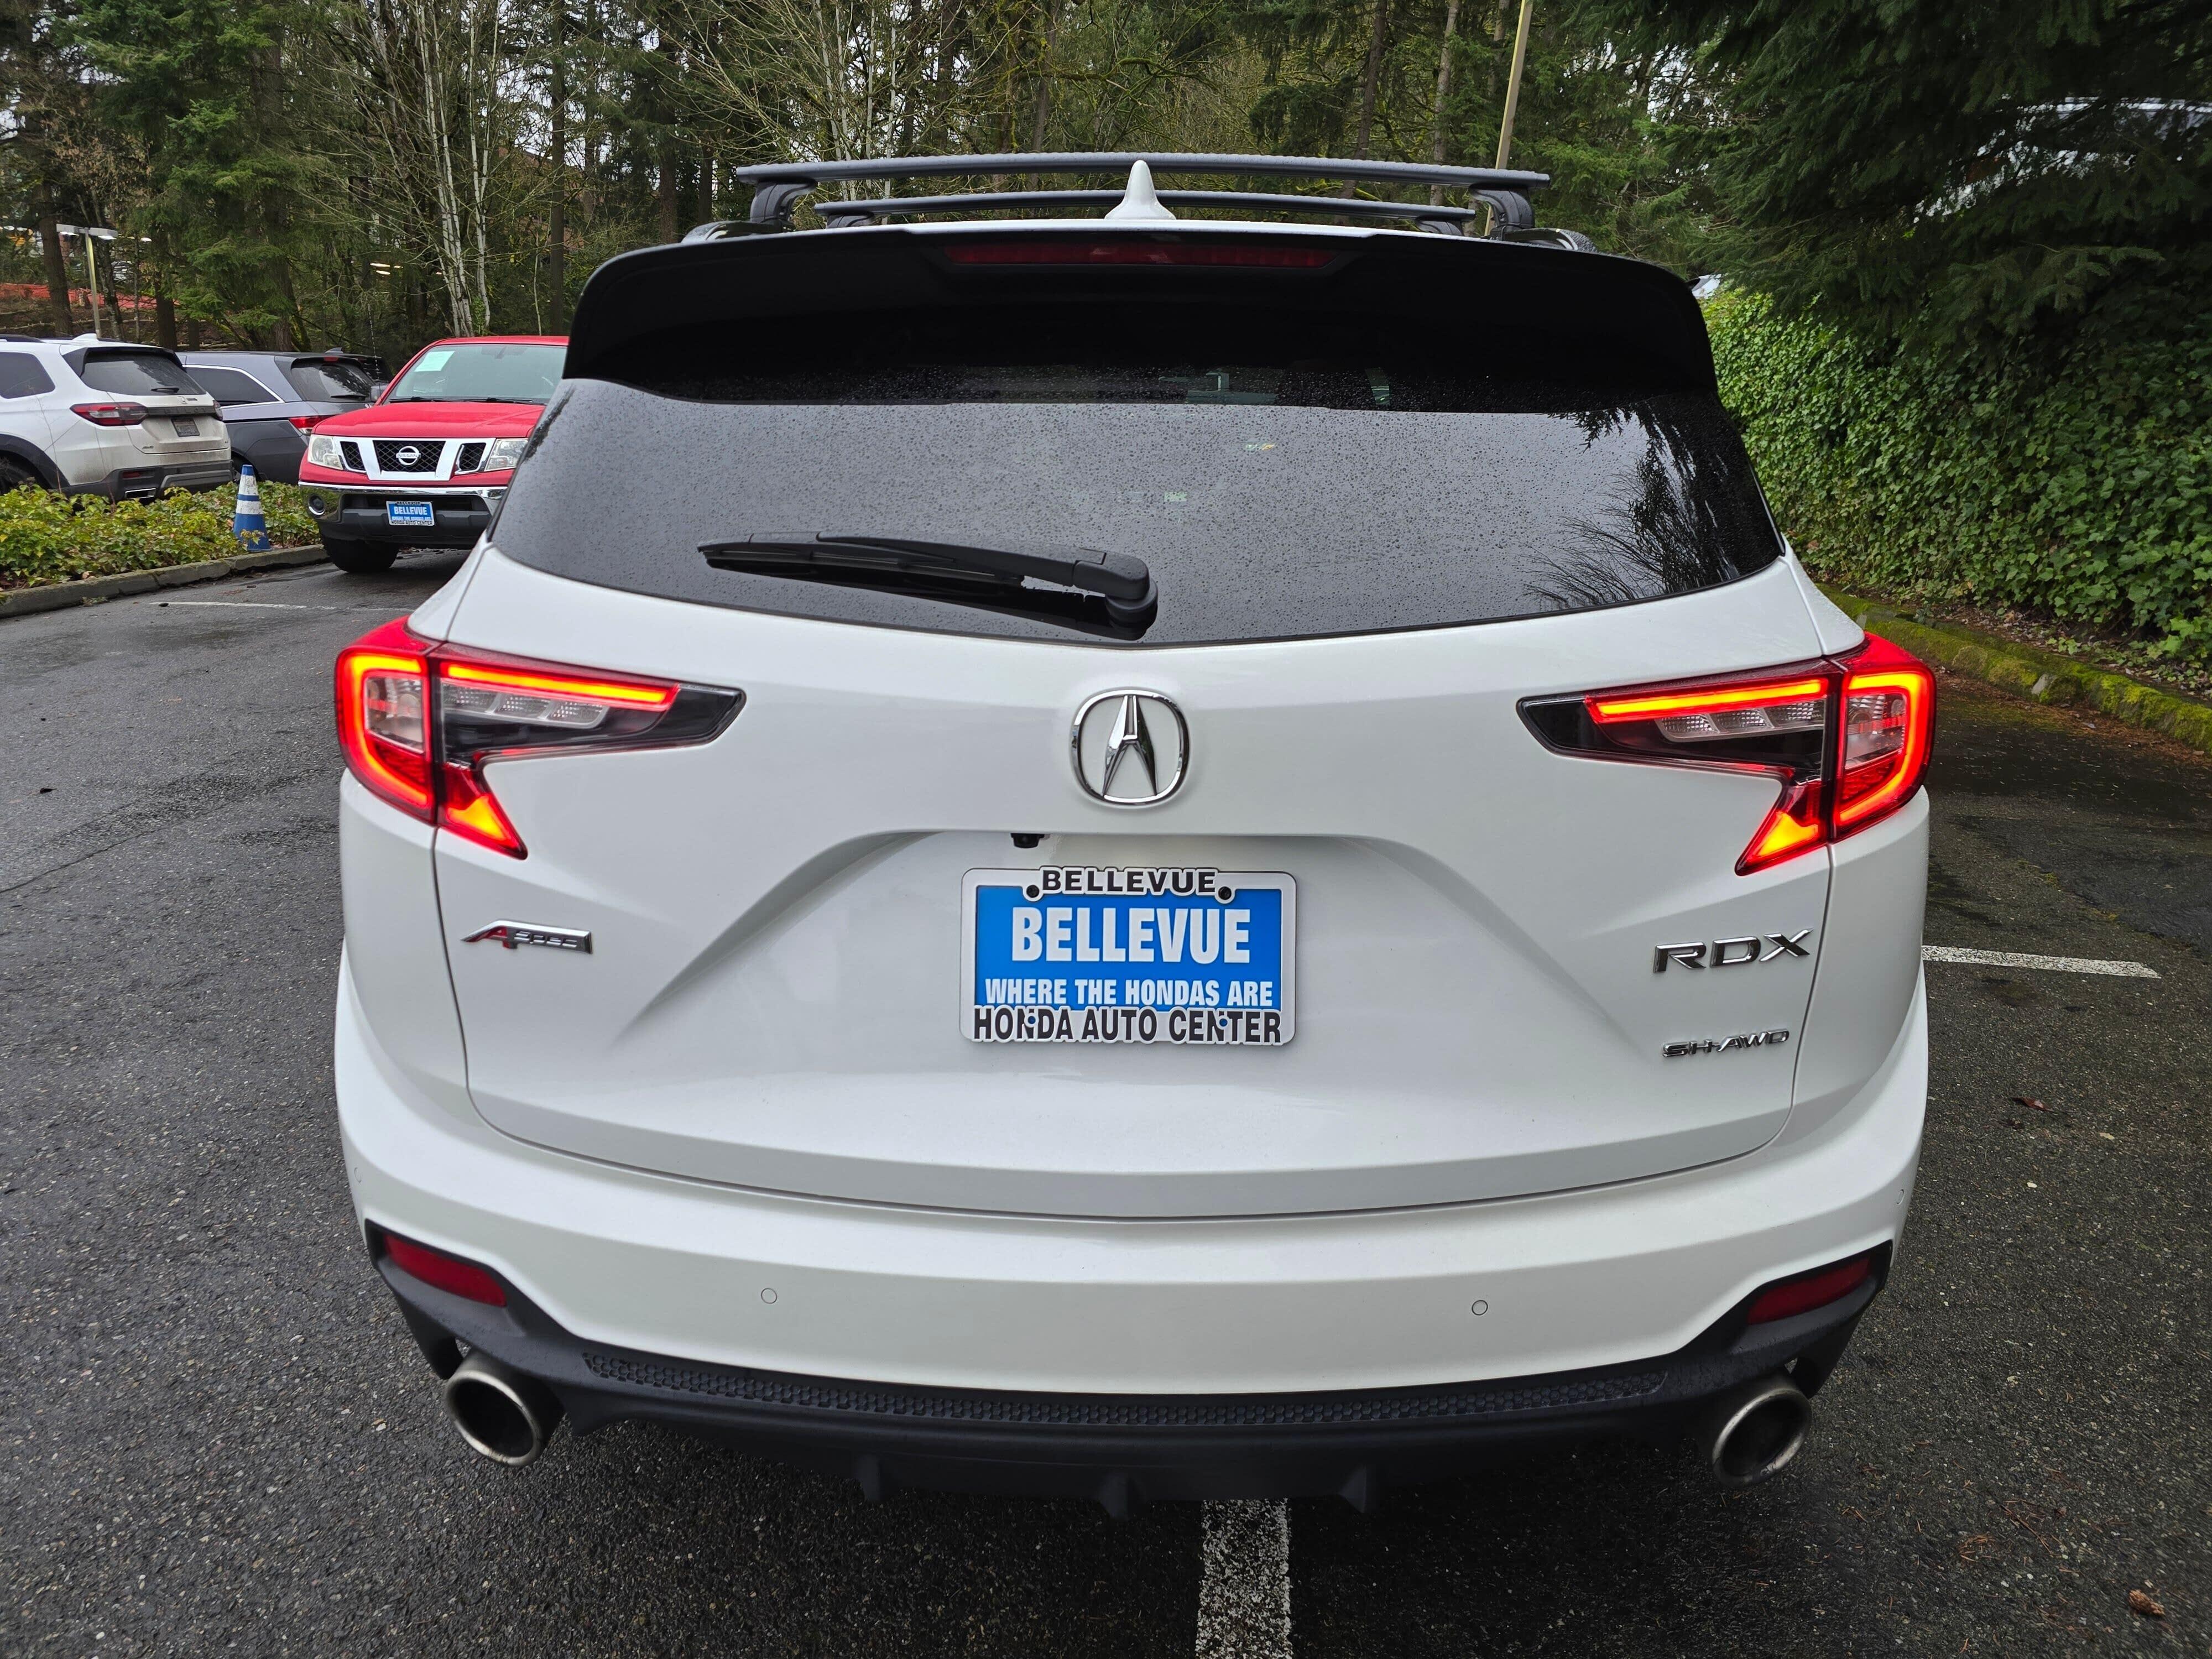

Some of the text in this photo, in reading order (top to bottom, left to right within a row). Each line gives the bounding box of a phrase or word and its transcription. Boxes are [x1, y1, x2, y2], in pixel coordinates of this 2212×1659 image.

[393, 506, 427, 515] BELLEVUE
[1042, 870, 1216, 893] BELLEVUE
[1012, 907, 1250, 964] BELLEVUE
[1653, 927, 1814, 973] RDX
[985, 978, 1272, 1006] WHERE THE HONDAS ARE
[974, 1008, 1281, 1043] HONDA AUTO CENTER
